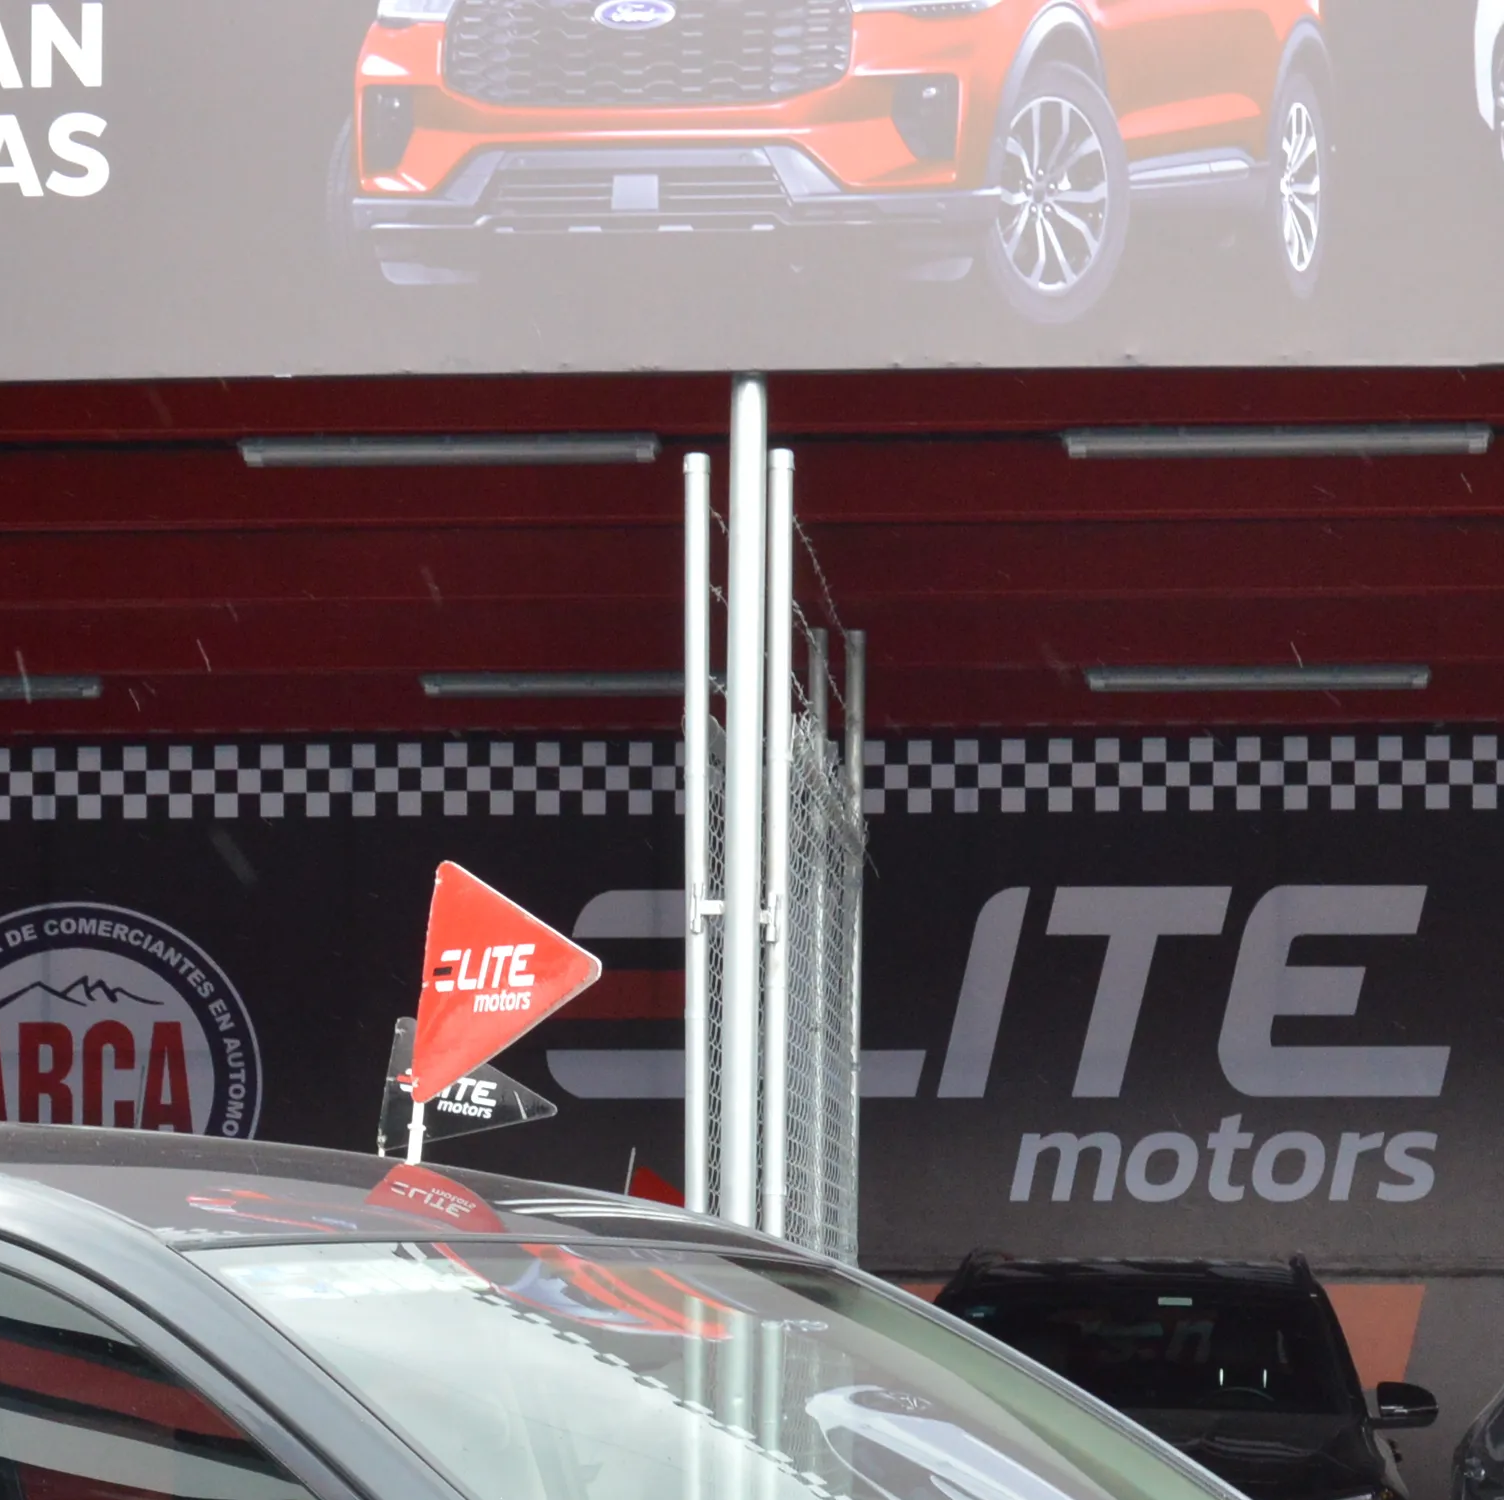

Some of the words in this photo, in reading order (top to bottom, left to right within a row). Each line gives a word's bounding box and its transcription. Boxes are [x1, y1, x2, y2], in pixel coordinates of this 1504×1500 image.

[4, 923, 38, 948] DE
[43, 917, 216, 999] COMERCIANTES
[208, 997, 236, 1032] EN
[433, 943, 537, 993] ELITE
[473, 988, 532, 1013] motors
[436, 1099, 494, 1120] motors
[1008, 1113, 1440, 1204] motors
